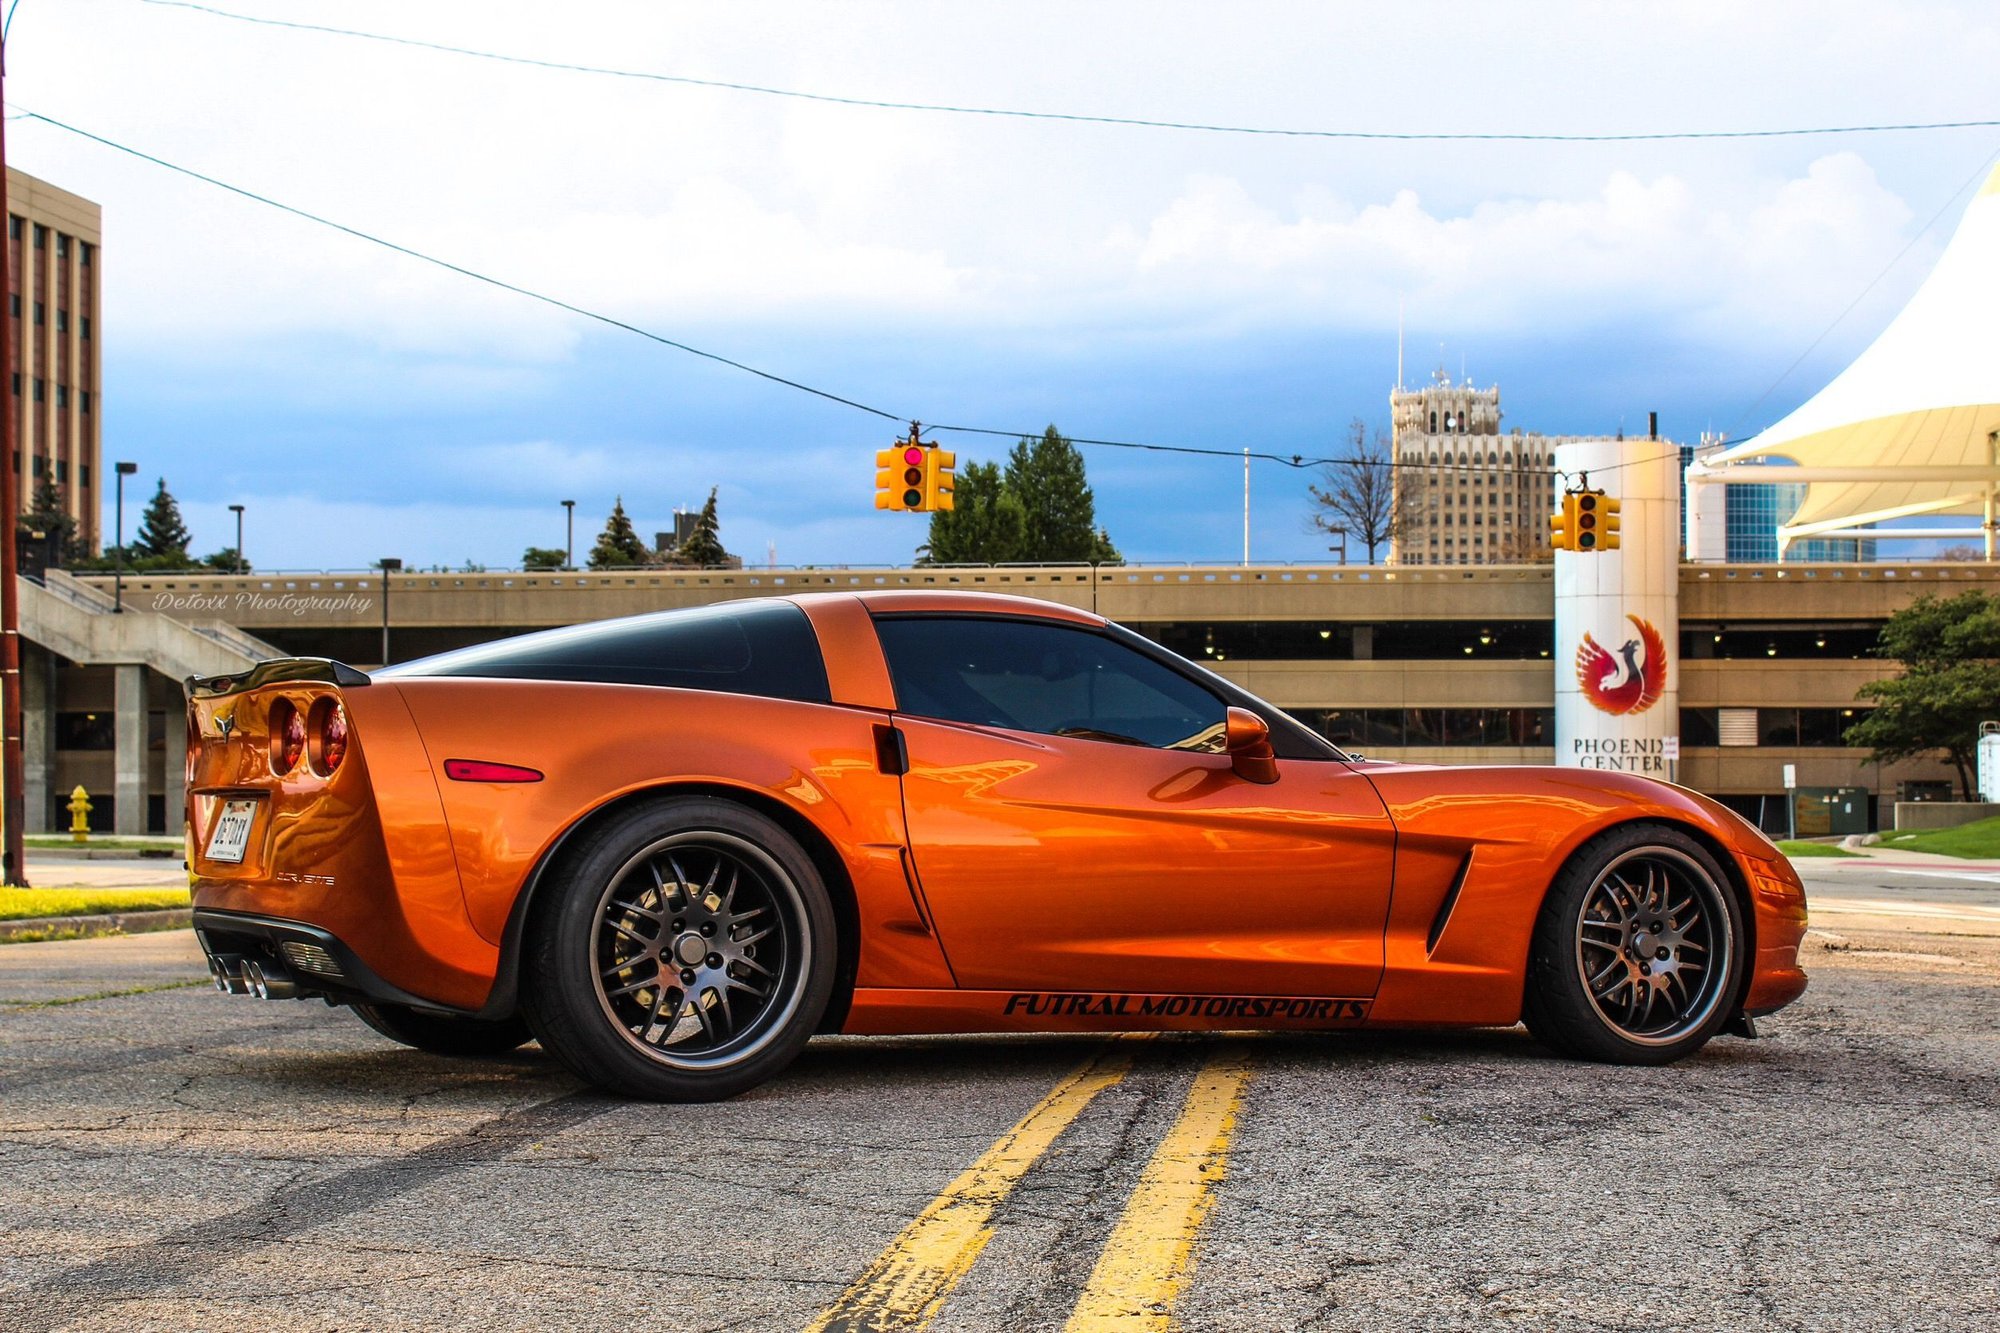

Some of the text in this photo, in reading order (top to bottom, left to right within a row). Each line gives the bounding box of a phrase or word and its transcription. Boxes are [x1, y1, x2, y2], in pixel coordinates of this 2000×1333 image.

[1580, 755, 1663, 771] CENTER
[1003, 993, 1369, 1019] FUTRAL MOTORSPORTS
